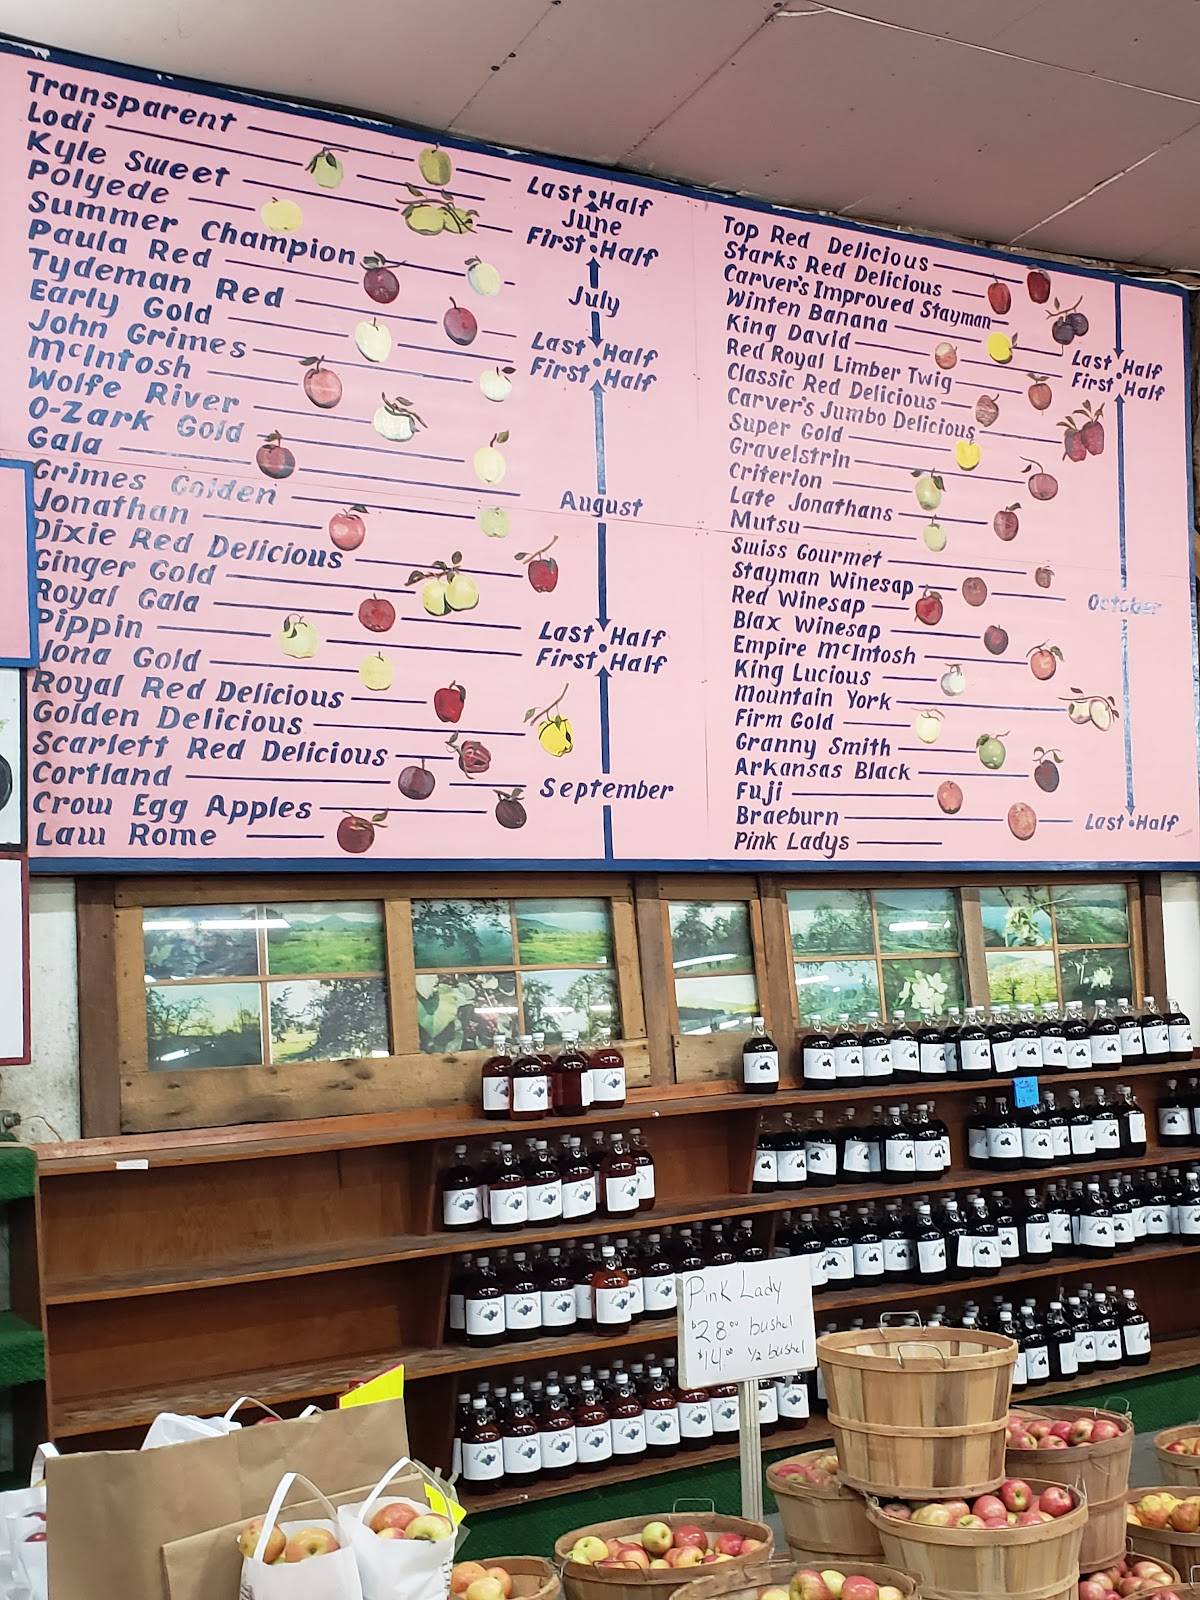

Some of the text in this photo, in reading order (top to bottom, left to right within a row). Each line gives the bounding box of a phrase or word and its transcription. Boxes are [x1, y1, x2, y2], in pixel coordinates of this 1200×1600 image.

[27, 71, 238, 132] Transparent
[28, 101, 96, 133] Lodi
[26, 131, 230, 187] Kyle Sweet
[28, 159, 169, 204] Polyede
[527, 176, 653, 217] Last Half
[29, 191, 356, 265] Summer Champion
[562, 209, 622, 236] June
[29, 219, 212, 268] Paula Red
[527, 226, 659, 267] First Half
[724, 215, 929, 271] Top Red Delicious
[29, 248, 284, 308] Tydeman Red
[724, 241, 942, 297] Starks Red Delicious
[30, 279, 212, 325] Early Gold
[568, 286, 620, 318] July
[724, 264, 991, 330] Carver's Improved Stayman
[29, 309, 247, 358] John Grimes
[726, 313, 851, 350] King David
[808, 304, 888, 333] Banana
[531, 332, 658, 368] Last Half
[727, 338, 952, 394] Red Royal Limber Twig
[1072, 350, 1163, 380] Last Half
[29, 367, 240, 412] Wolfe River
[530, 356, 657, 392] First Half
[728, 363, 937, 410] Classic Red Delicious
[1072, 372, 1165, 401] First Half
[29, 396, 245, 442] O-Zark Gold
[728, 387, 976, 439] Carver's Jumbo Delicious
[729, 413, 844, 443] Super Gold
[28, 426, 103, 455] Gala
[34, 459, 278, 506] Grimes Golden
[729, 462, 822, 490] Criterion
[35, 487, 189, 525] Jonathan
[560, 490, 644, 518] August
[730, 486, 893, 522] Late Jonathans
[730, 510, 800, 535] Mutsu
[35, 517, 343, 568] Dixie Red Delicious
[732, 537, 882, 568] Swiss Gourmet
[36, 549, 217, 585] Ginger Gold
[732, 562, 913, 600] Stayman Winesap
[38, 578, 199, 613] Royal Gala
[732, 585, 865, 618] Red Winesap
[39, 608, 143, 642] Pippin
[538, 621, 667, 648] Last Half
[733, 610, 880, 643] Blax Winesap
[40, 639, 201, 672] Jona Gold
[536, 648, 668, 674] First Half
[734, 635, 806, 660] Empire
[32, 670, 344, 708] Royal Red Delicious
[735, 659, 871, 687] King Lucious
[734, 684, 892, 710] Mountain York
[32, 699, 303, 735] Golden Delicious
[735, 709, 834, 731] Firm Gold
[32, 730, 388, 767] Scarlett Red Delicious
[736, 733, 891, 760] Granny Smith
[32, 761, 172, 787] Cortland
[735, 758, 911, 780] Arkansas Black
[540, 777, 674, 804] September
[736, 782, 782, 806] Fuji
[32, 791, 312, 825] Crow Egg Apples
[736, 806, 839, 825] Braeburn
[1085, 813, 1179, 832] Last Half
[36, 822, 216, 847] Law Rome
[734, 832, 850, 859] Pink Ladys
[686, 1275, 731, 1311] Pink
[740, 1270, 782, 1304] Lady
[750, 1315, 792, 1336] bushel
[768, 1340, 804, 1359] bushel
